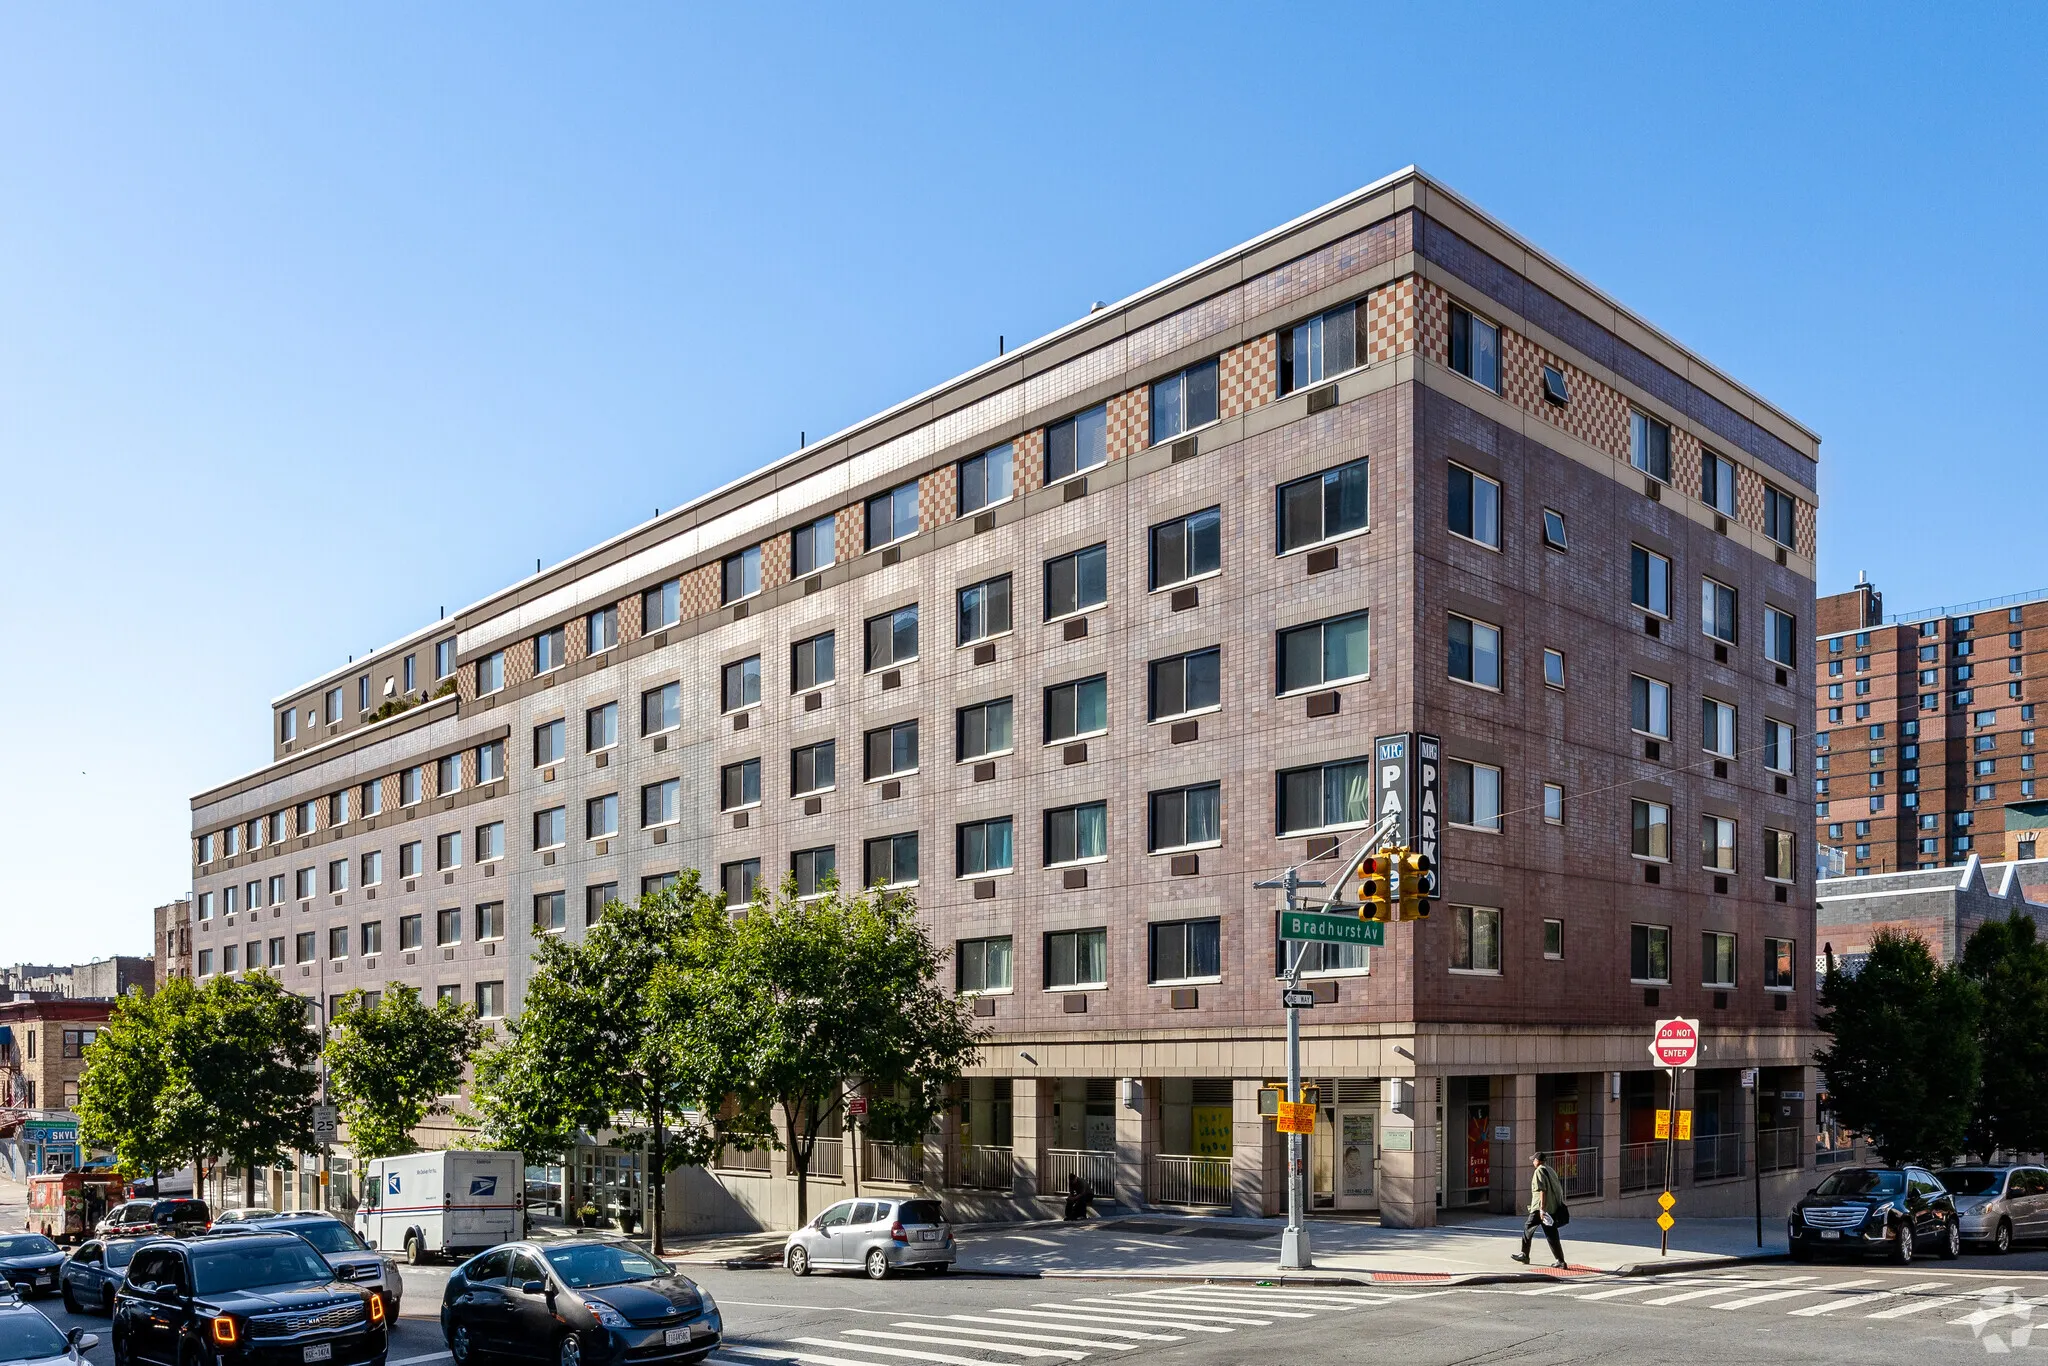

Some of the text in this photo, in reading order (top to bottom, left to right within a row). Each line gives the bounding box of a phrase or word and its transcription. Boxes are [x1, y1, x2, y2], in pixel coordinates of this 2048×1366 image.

[1421, 764, 1437, 865] PARK
[1292, 918, 1378, 940] Bradhurst Av
[1287, 994, 1311, 1002] ONE WAY
[1662, 1029, 1691, 1037] DO NOT
[1663, 1049, 1687, 1057] ENTER
[317, 1121, 334, 1131] 25
